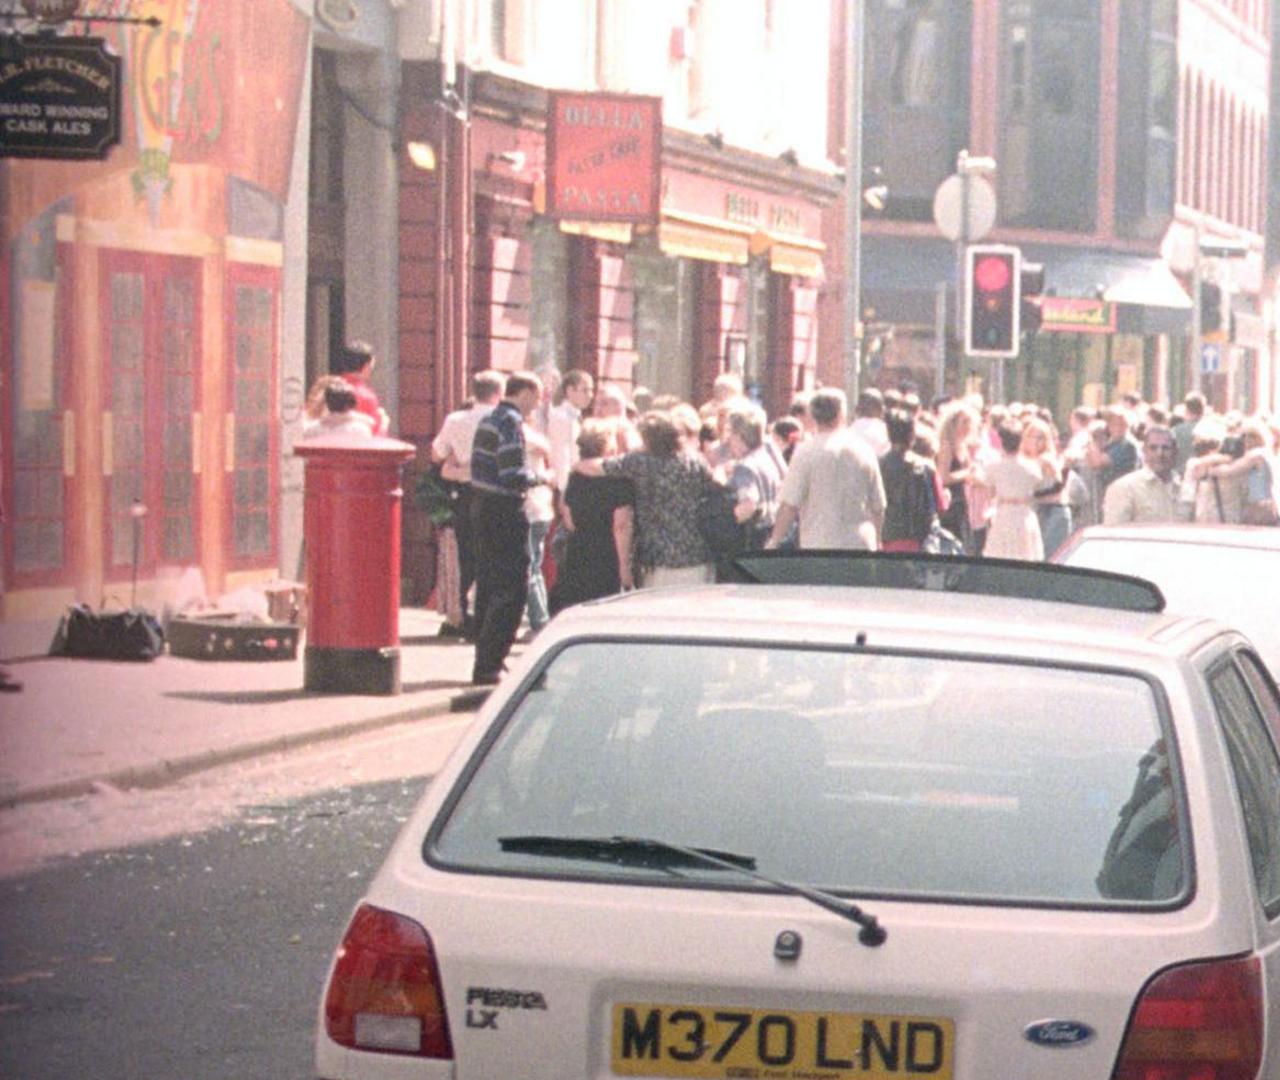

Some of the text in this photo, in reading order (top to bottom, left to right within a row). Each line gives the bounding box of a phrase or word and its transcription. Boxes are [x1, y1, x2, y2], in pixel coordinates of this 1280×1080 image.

[45, 104, 109, 120] WINNING
[565, 105, 643, 129] BELLA
[6, 119, 91, 135] CASK ALES
[562, 186, 644, 211] PASTA
[466, 1010, 500, 1029] LX
[621, 1006, 945, 1075] M370 LND
